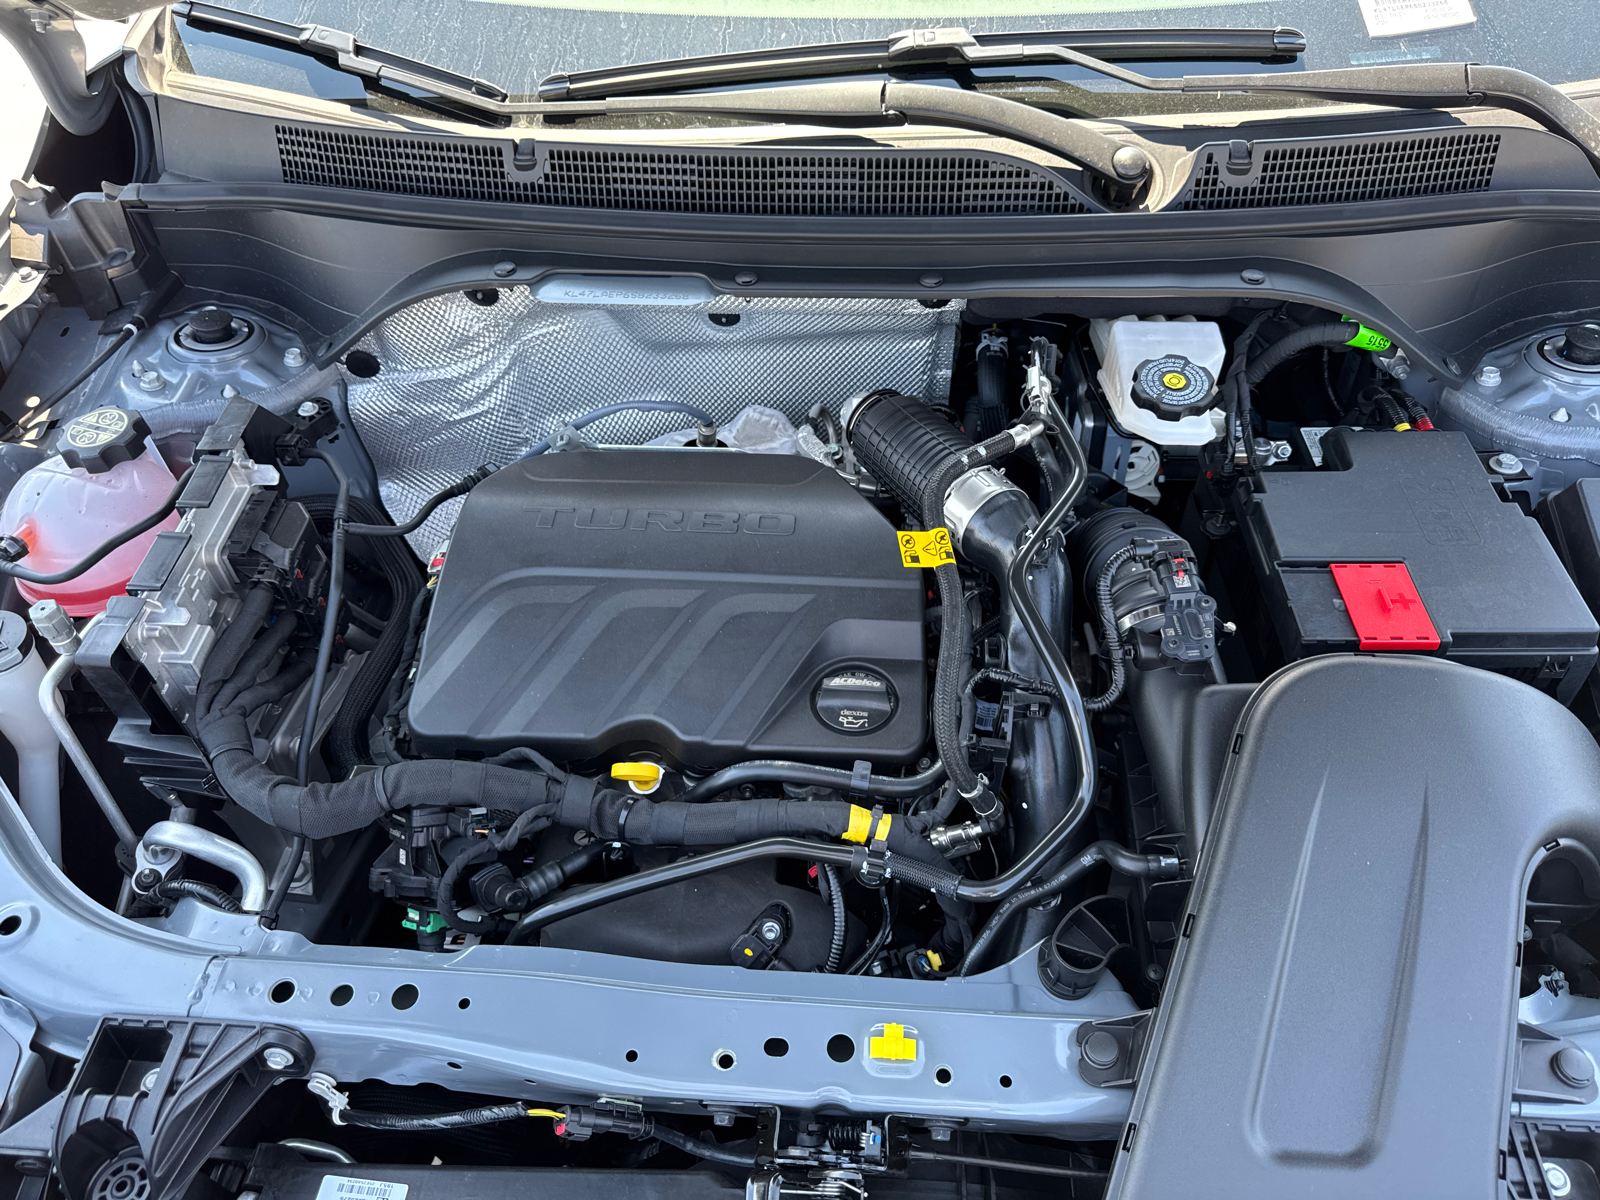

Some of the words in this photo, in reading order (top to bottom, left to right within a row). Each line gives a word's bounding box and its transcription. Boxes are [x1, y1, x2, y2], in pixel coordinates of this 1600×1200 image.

[1366, 335, 1390, 350] 5515
[522, 506, 796, 536] TURBO
[829, 677, 881, 687] ACDelco
